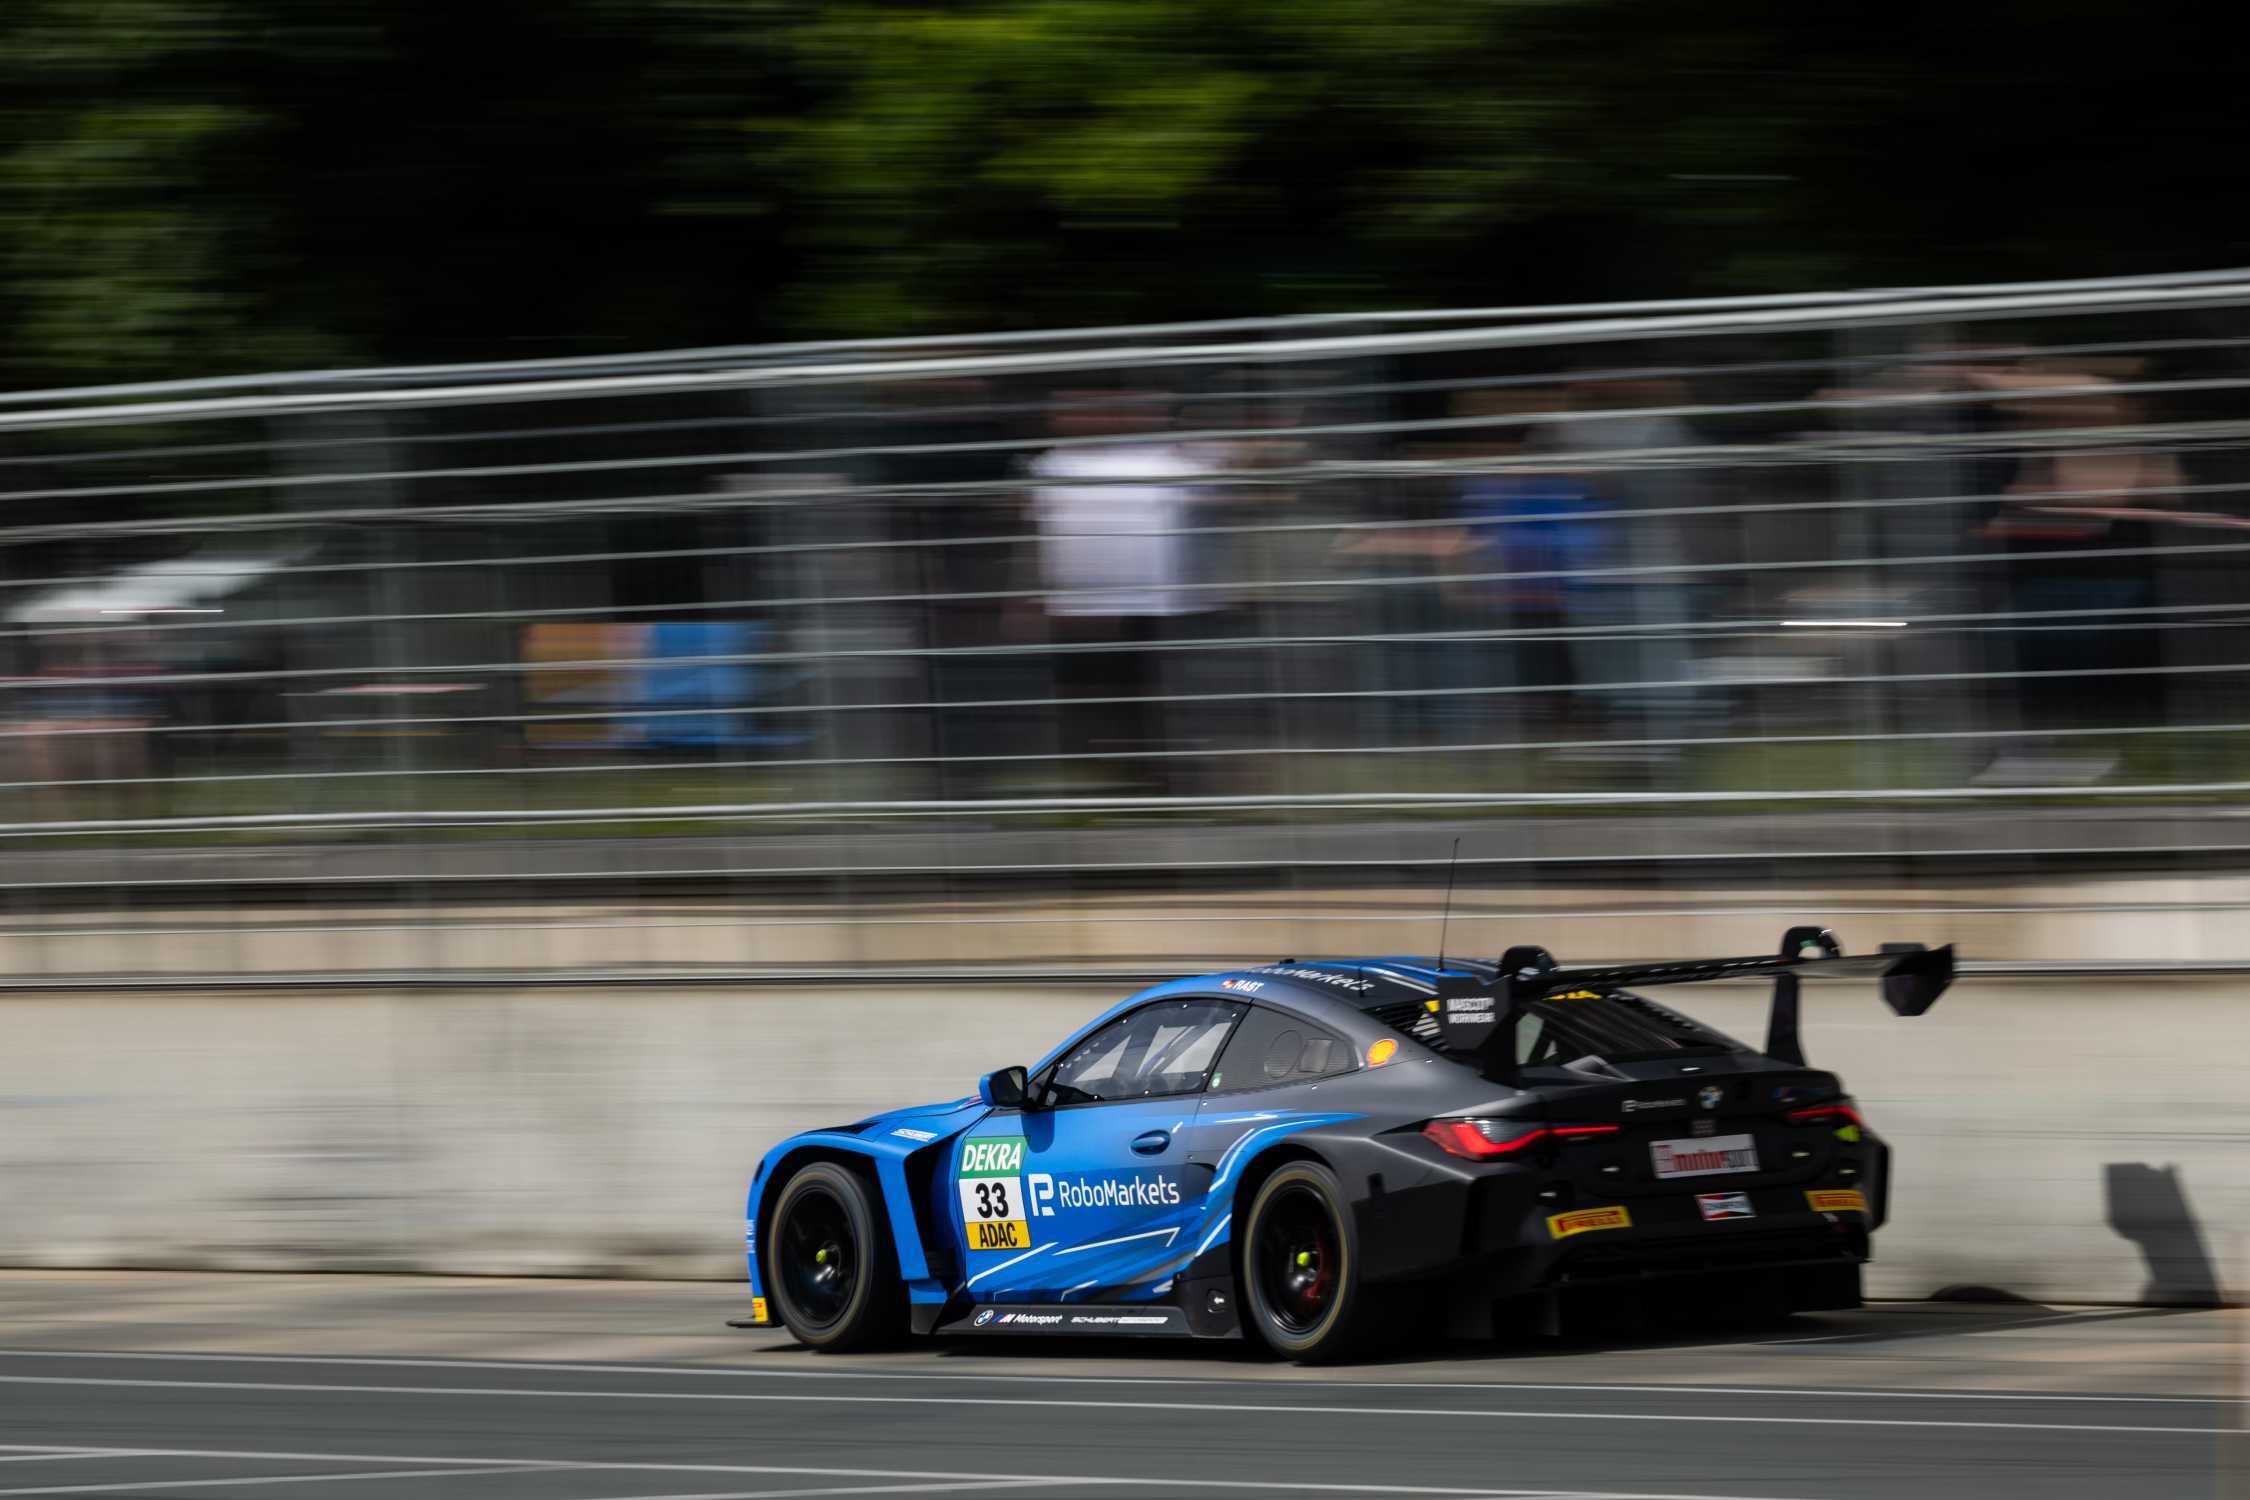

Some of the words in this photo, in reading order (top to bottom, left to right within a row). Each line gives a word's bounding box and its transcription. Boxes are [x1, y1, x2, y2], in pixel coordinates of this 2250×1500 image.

[1232, 980, 1264, 993] RAST
[961, 1143, 1022, 1172] DEKRA
[975, 1182, 1009, 1219] 33
[1058, 1174, 1181, 1208] RoboMarkets
[979, 1222, 1018, 1249] ADAC
[1014, 1314, 1063, 1325] Motorsport
